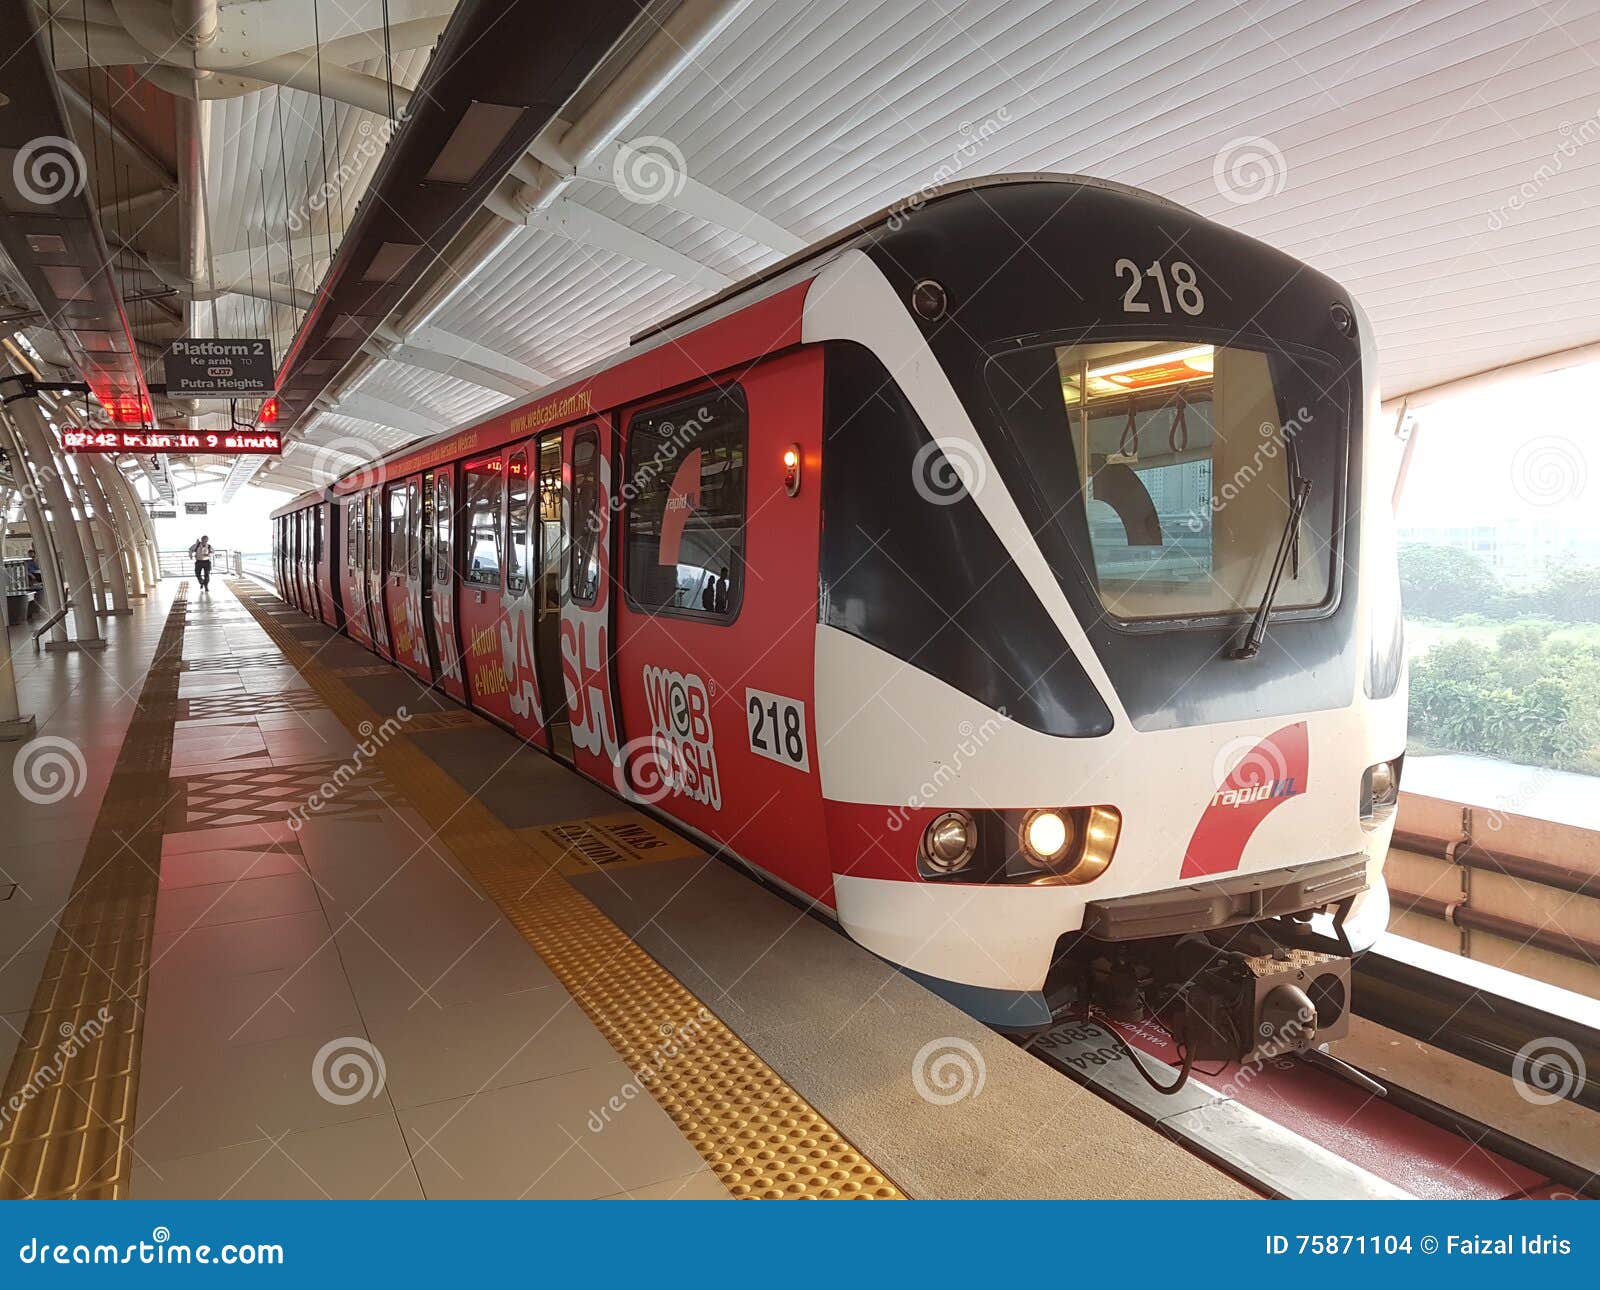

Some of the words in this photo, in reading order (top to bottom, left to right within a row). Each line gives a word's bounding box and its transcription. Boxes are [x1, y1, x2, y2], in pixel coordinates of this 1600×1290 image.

[1115, 258, 1204, 316] 218
[172, 342, 248, 356] Platform
[252, 342, 265, 355] 2
[190, 357, 205, 366] Ke
[208, 357, 232, 366] arah
[241, 358, 253, 366] TO
[181, 379, 214, 388] Putra
[217, 379, 264, 390] Heights
[179, 432, 200, 448] in
[206, 433, 218, 448] 9
[750, 696, 803, 763] 218
[652, 728, 722, 811] CASH
